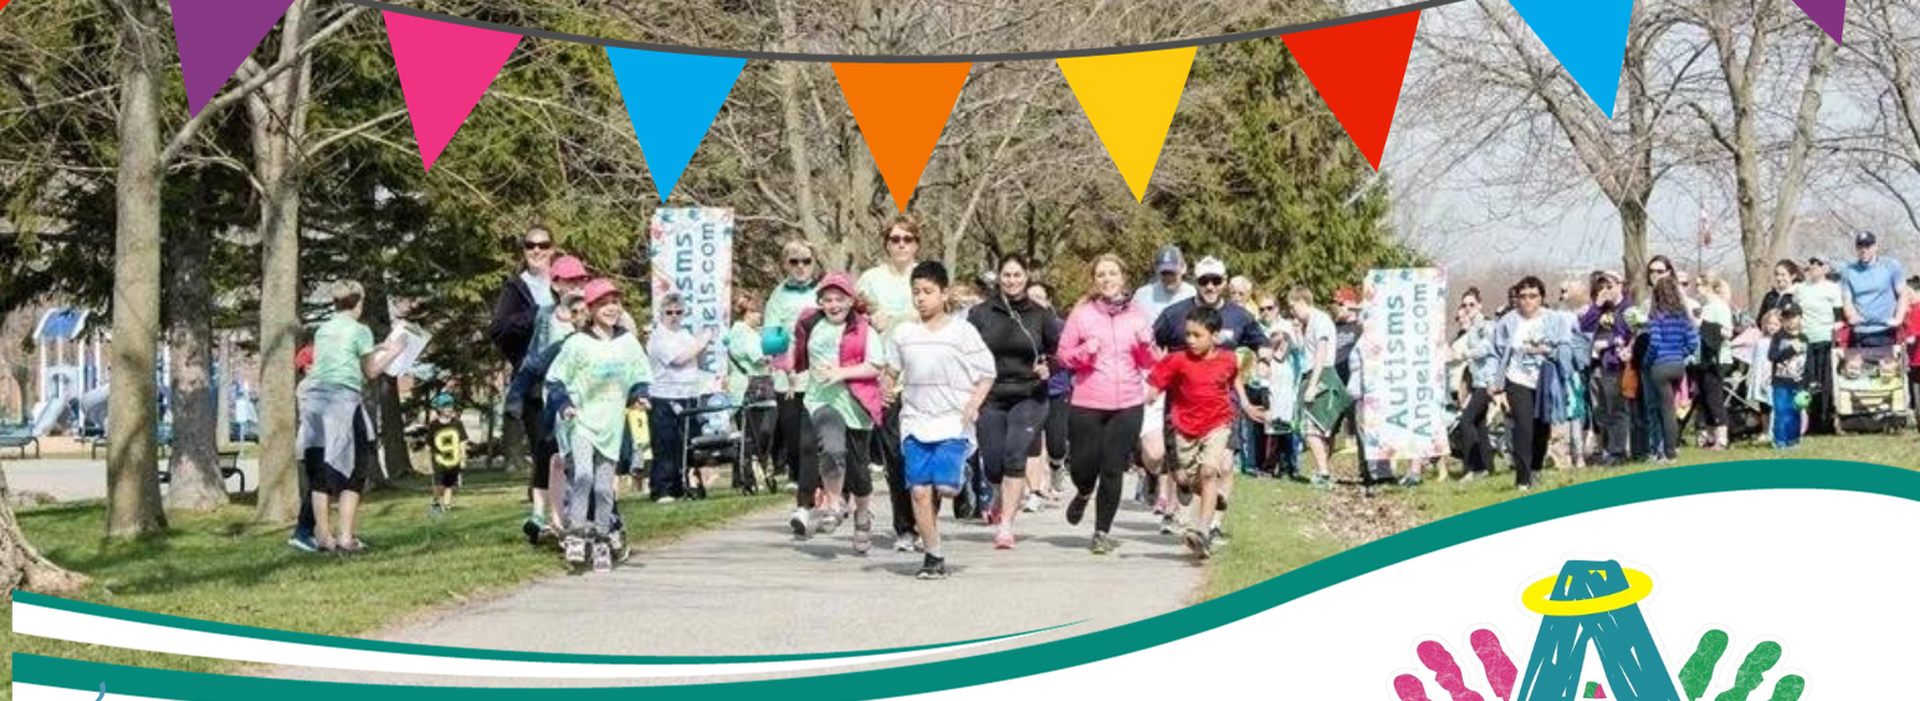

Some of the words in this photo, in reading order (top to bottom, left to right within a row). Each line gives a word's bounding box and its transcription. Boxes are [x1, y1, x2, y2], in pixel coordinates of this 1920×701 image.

[675, 232, 695, 335] isms
[1386, 295, 1409, 429] Autisms
[1412, 283, 1434, 437] Angels.com
[434, 428, 460, 467] 9
